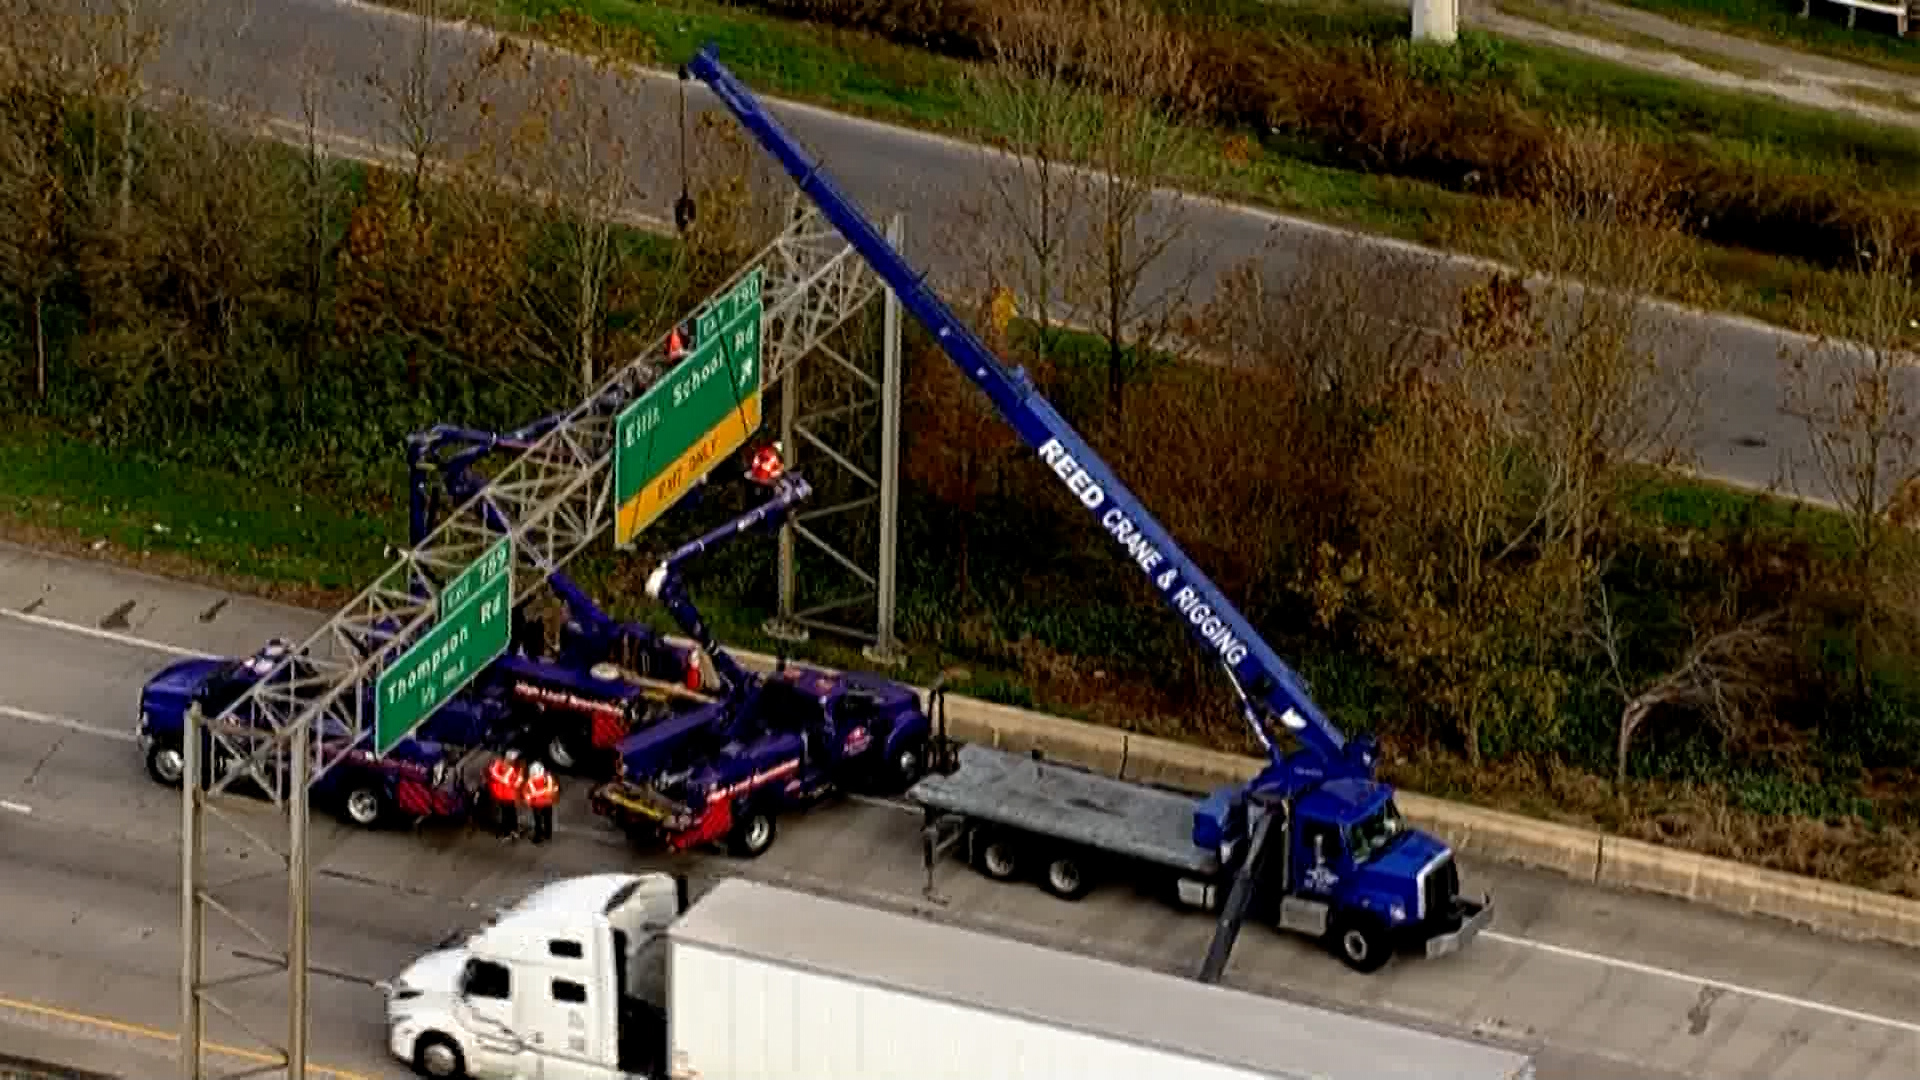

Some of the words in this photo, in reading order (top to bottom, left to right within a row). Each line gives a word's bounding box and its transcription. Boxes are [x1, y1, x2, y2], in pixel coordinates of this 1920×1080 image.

[672, 345, 724, 408] School
[735, 320, 754, 353] Rd
[703, 307, 725, 336] EXT
[1039, 439, 1104, 508] REED
[1102, 508, 1164, 574] CRANE
[1156, 568, 1178, 591] &
[1172, 584, 1247, 666] RIGGING
[388, 624, 468, 704] Thompson
[480, 592, 501, 624] Rd
